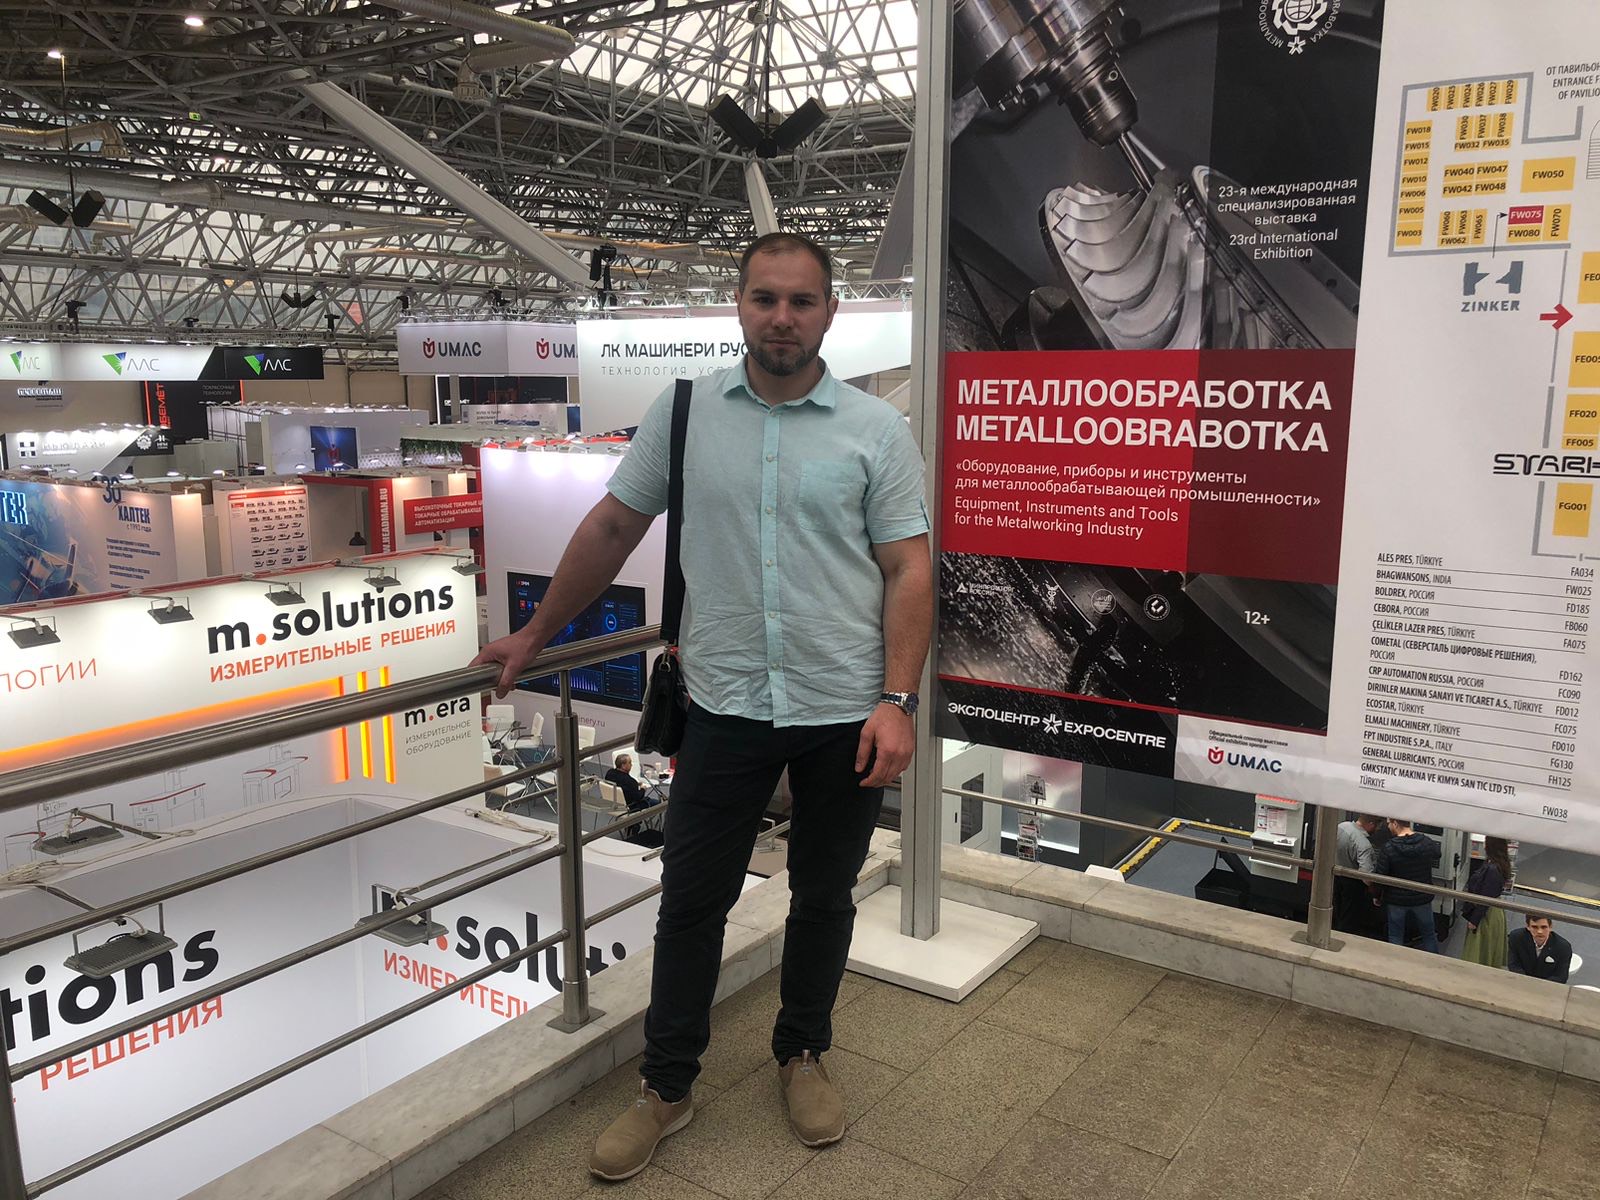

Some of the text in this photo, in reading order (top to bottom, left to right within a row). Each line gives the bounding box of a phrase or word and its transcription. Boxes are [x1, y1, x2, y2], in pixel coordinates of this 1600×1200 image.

[1546, 66, 1556, 76] ОТ
[1552, 76, 1593, 88] ENTRANCE
[1558, 90, 1568, 100] OF
[1454, 142, 1480, 150] FW032
[1404, 158, 1428, 166] FW012
[1477, 165, 1508, 174] FW047
[1402, 176, 1426, 184] FW010
[1444, 168, 1475, 177] FW040
[1532, 170, 1564, 179] FW050
[1218, 178, 1358, 198] 23-я международная
[1443, 185, 1472, 194] FW042
[1474, 182, 1506, 192] FW048
[1217, 194, 1356, 212] специализированная
[1254, 212, 1317, 226] выставка
[1510, 210, 1542, 219] FW075
[1550, 208, 1562, 237] FW070
[1229, 228, 1338, 246] 23rd International
[1397, 229, 1422, 238] FW003
[1508, 230, 1540, 238] FW080
[1254, 246, 1313, 260] Exhibition
[1460, 300, 1520, 312] ZINKER
[438, 342, 482, 358] UMAC
[552, 343, 578, 358] UM
[601, 344, 621, 358] ЛК
[625, 342, 715, 358] МАШИНЕРИ
[601, 366, 687, 376] ТЕХНОЛОГИЯ
[957, 378, 1332, 411] МЕТАЛЛООБРАБОТКА
[1569, 410, 1597, 418] FF020
[956, 415, 1329, 452] METALLOOBRABOTKA
[1566, 439, 1594, 447] FF005
[956, 458, 1247, 485] «Оборудование, приборы и инструменты
[955, 477, 1321, 508] для металлообрабатывающей промышленности»
[454, 500, 477, 508] ТОКАРНЫЕ
[955, 496, 1179, 522] Equipment, Instruments and Tools
[1558, 502, 1587, 511] FG001
[954, 512, 1144, 540] for the Metalworking Industry
[1377, 552, 1394, 562] ALES
[1396, 554, 1414, 565] PRES,
[1570, 566, 1594, 578] FA034
[1376, 570, 1592, 596] BHAGWANSONS, INDIA FW025
[1375, 586, 1590, 614] BOLDREX, РОССИЯ FD185
[207, 585, 454, 654] m.solutions
[1244, 610, 1270, 624] 12+
[1374, 603, 1588, 632] CEBORA, РОССИЯ FB060
[1404, 622, 1426, 634] LAZER
[1427, 626, 1446, 637] PRES,
[1563, 638, 1586, 650] FA075
[210, 620, 456, 682] ИЗМЕРИТЕЛЬНЫЕ РЕШЕНИЯ
[1371, 636, 1538, 664] COMETAL (СЕВЕРСТАЛЬ ЦИФРОВЫЕ РЕШЕНИЯ),
[1370, 650, 1583, 683] РОССИЯ FD162
[1368, 666, 1581, 700] CRP AUTOMATION RUSSIA, РОССИЯ FC090
[1368, 682, 1399, 694] DIRINLER
[1400, 684, 1428, 698] MAKINA
[1428, 690, 1454, 702] SANAYI
[1454, 693, 1464, 703] VE
[1465, 694, 1495, 708] TICARET
[1555, 706, 1579, 718] FD012
[404, 696, 470, 728] m.era
[948, 702, 1040, 730] ЭКСПОЦЕНТР
[1366, 698, 1397, 712] ECOSTAR,
[1554, 723, 1577, 736] FC075
[406, 720, 472, 744] ИЗМЕРИТЕЛЬНОЕ
[1064, 720, 1167, 749] EXPOCENTRE
[1365, 714, 1390, 726] ELMALI
[1390, 718, 1432, 733] MACHINERY,
[1552, 740, 1575, 753] FD010
[406, 730, 472, 755] ОБОРУДОВАНИЕ
[1363, 730, 1376, 740] FPT
[1376, 732, 1412, 746] INDUSTRIE
[1434, 741, 1453, 752] ITALY
[1550, 758, 1574, 770] FG130
[1227, 752, 1282, 774] UMAC
[1362, 746, 1572, 788] GENERAL LUBRICANTS, РОССИЯ FH125
[1361, 762, 1398, 777] GMKSTATIC
[1398, 768, 1426, 781] MAKINA
[1427, 772, 1436, 783] VE
[1437, 774, 1460, 786] KIMYA
[1460, 778, 1476, 789] SAN
[1476, 780, 1488, 792] TIC
[1488, 782, 1502, 794] LTD
[1542, 806, 1568, 819] FW038
